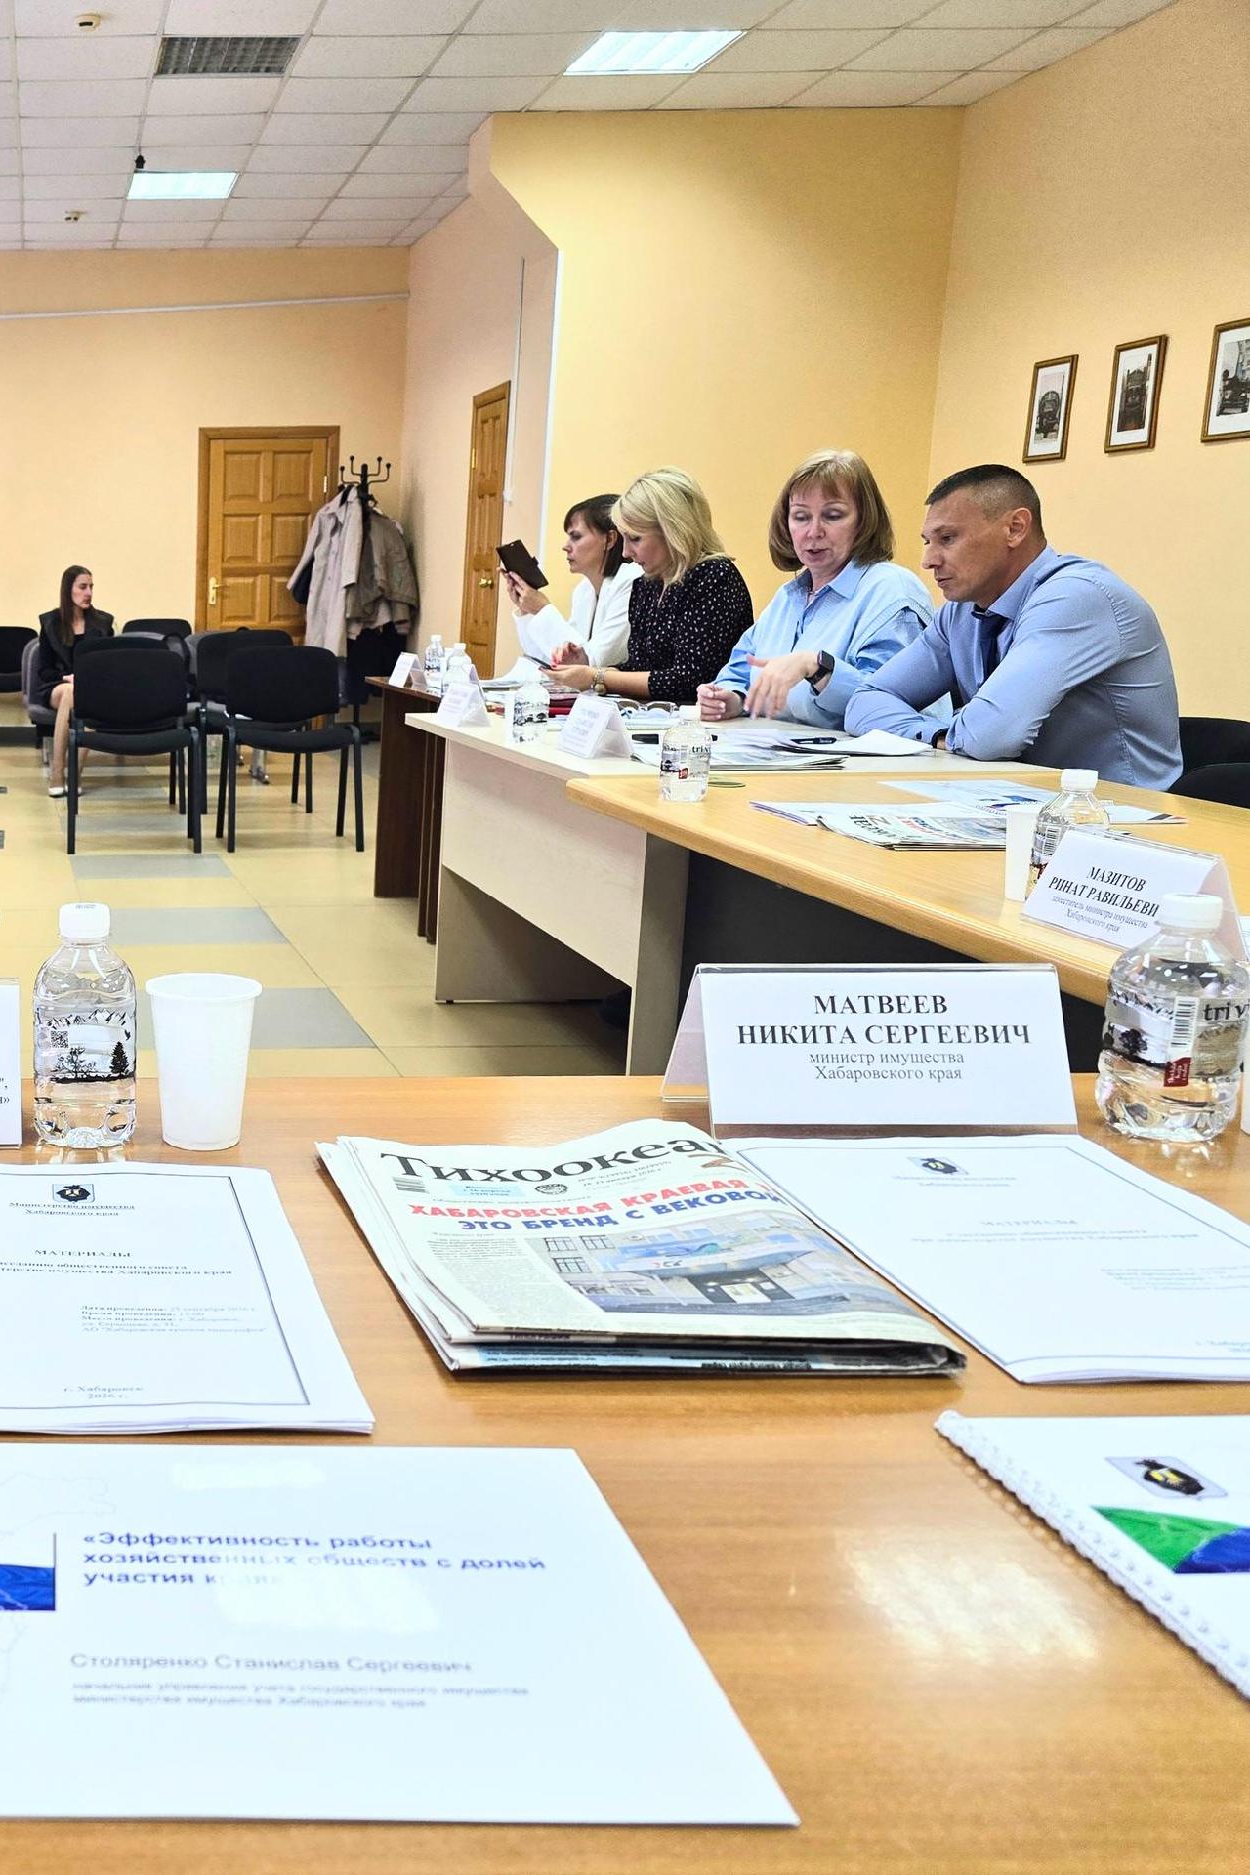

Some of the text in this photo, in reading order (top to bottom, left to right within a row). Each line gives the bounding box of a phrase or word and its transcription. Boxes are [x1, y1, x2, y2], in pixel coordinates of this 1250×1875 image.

[1086, 866, 1146, 892] МАЗИТОВ
[1049, 877, 1160, 917] РИНАТ РАВИЛЬЕВИ
[814, 995, 948, 1015] МАТВЕЕВ
[736, 1025, 1031, 1045] НИКИТА СЕРГЕЕВИЧ
[810, 1052, 964, 1066] министр имущества
[815, 1065, 962, 1083] Хабаровского края
[380, 1138, 723, 1183] Тихоокеа
[410, 1200, 612, 1218] ХАБАРОВСКАЯ
[621, 1179, 746, 1207] КРАЕВАЯ
[458, 1220, 512, 1230] ЭТО
[523, 1215, 618, 1230] БРЕНД
[626, 1208, 643, 1220] С
[83, 1532, 432, 1550] «Эффективность работы
[437, 1559, 451, 1568] с
[460, 1558, 546, 1571] долей
[83, 1570, 195, 1587] участия
[70, 1654, 473, 1675] Столяренко Станислав Сергеевич
